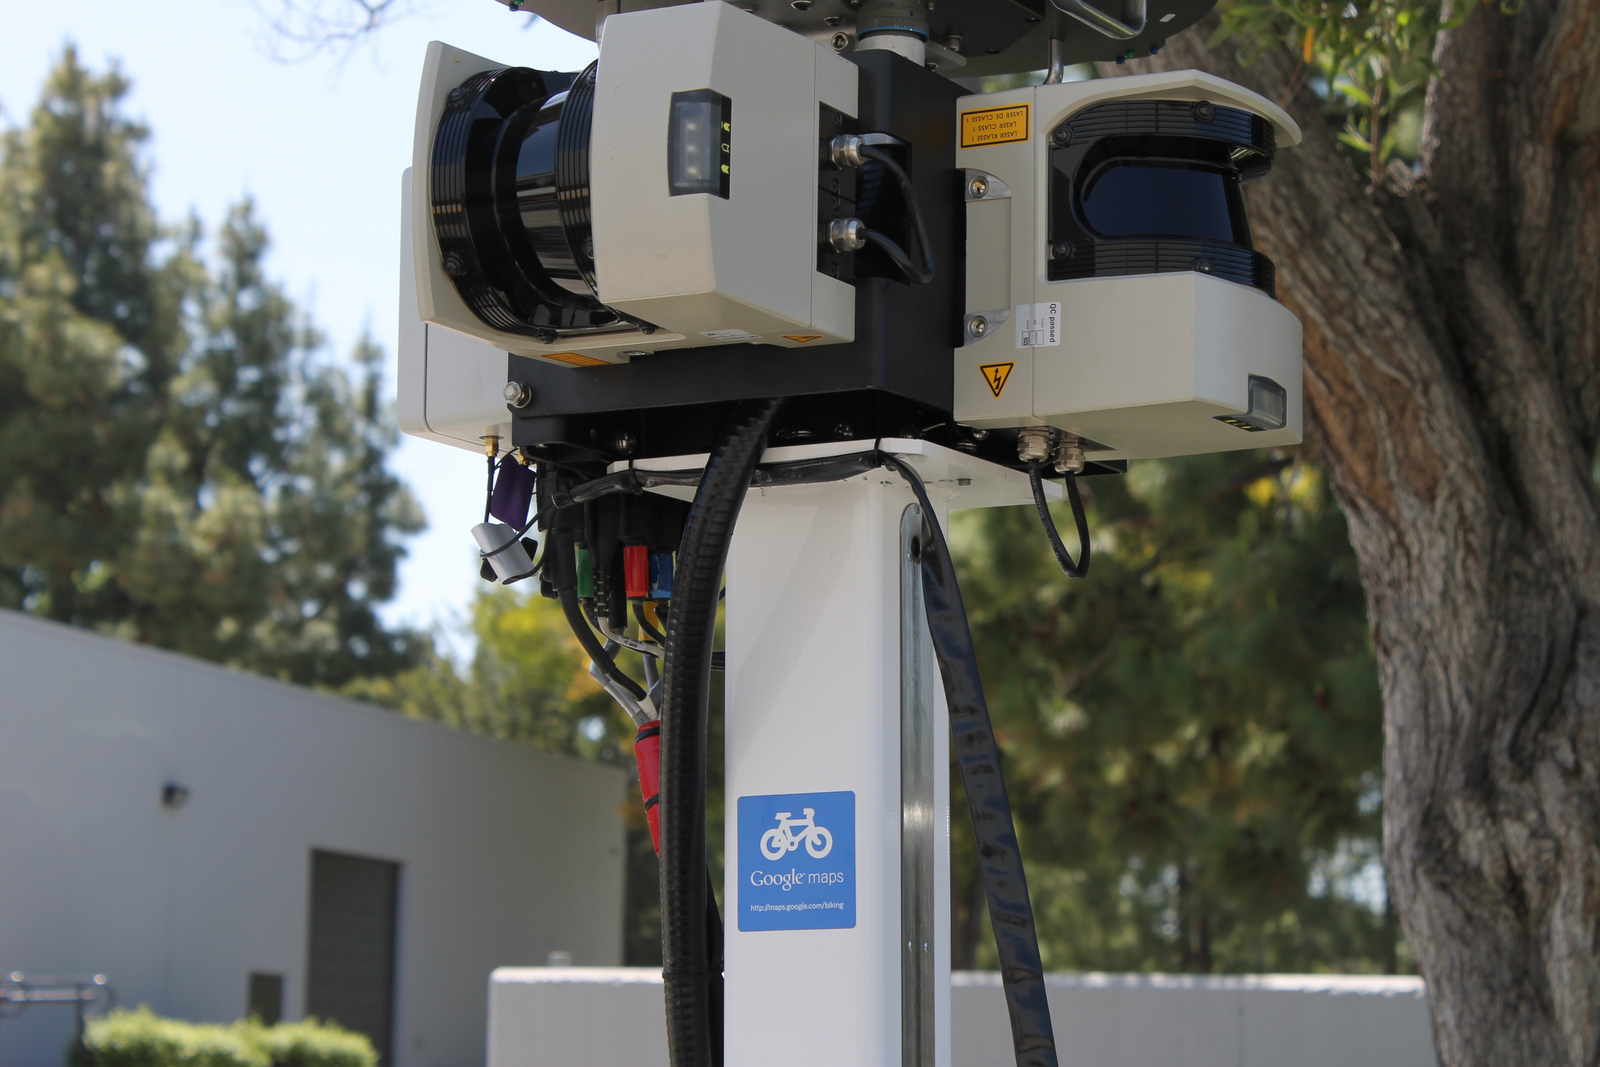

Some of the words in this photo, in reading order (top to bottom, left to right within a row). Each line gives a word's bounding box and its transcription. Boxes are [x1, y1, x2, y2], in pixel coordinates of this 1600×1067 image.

[972, 114, 994, 123] CLASSE
[1006, 110, 1024, 118] LASER
[978, 123, 997, 132] CLASS
[999, 121, 1017, 129] LASER
[977, 133, 998, 142] KLASSE
[1000, 130, 1018, 139] LASER
[1049, 303, 1057, 315] QC
[750, 868, 804, 891] Google
[808, 872, 844, 886] maps
[750, 901, 844, 912] http://maps.google.com/biking
